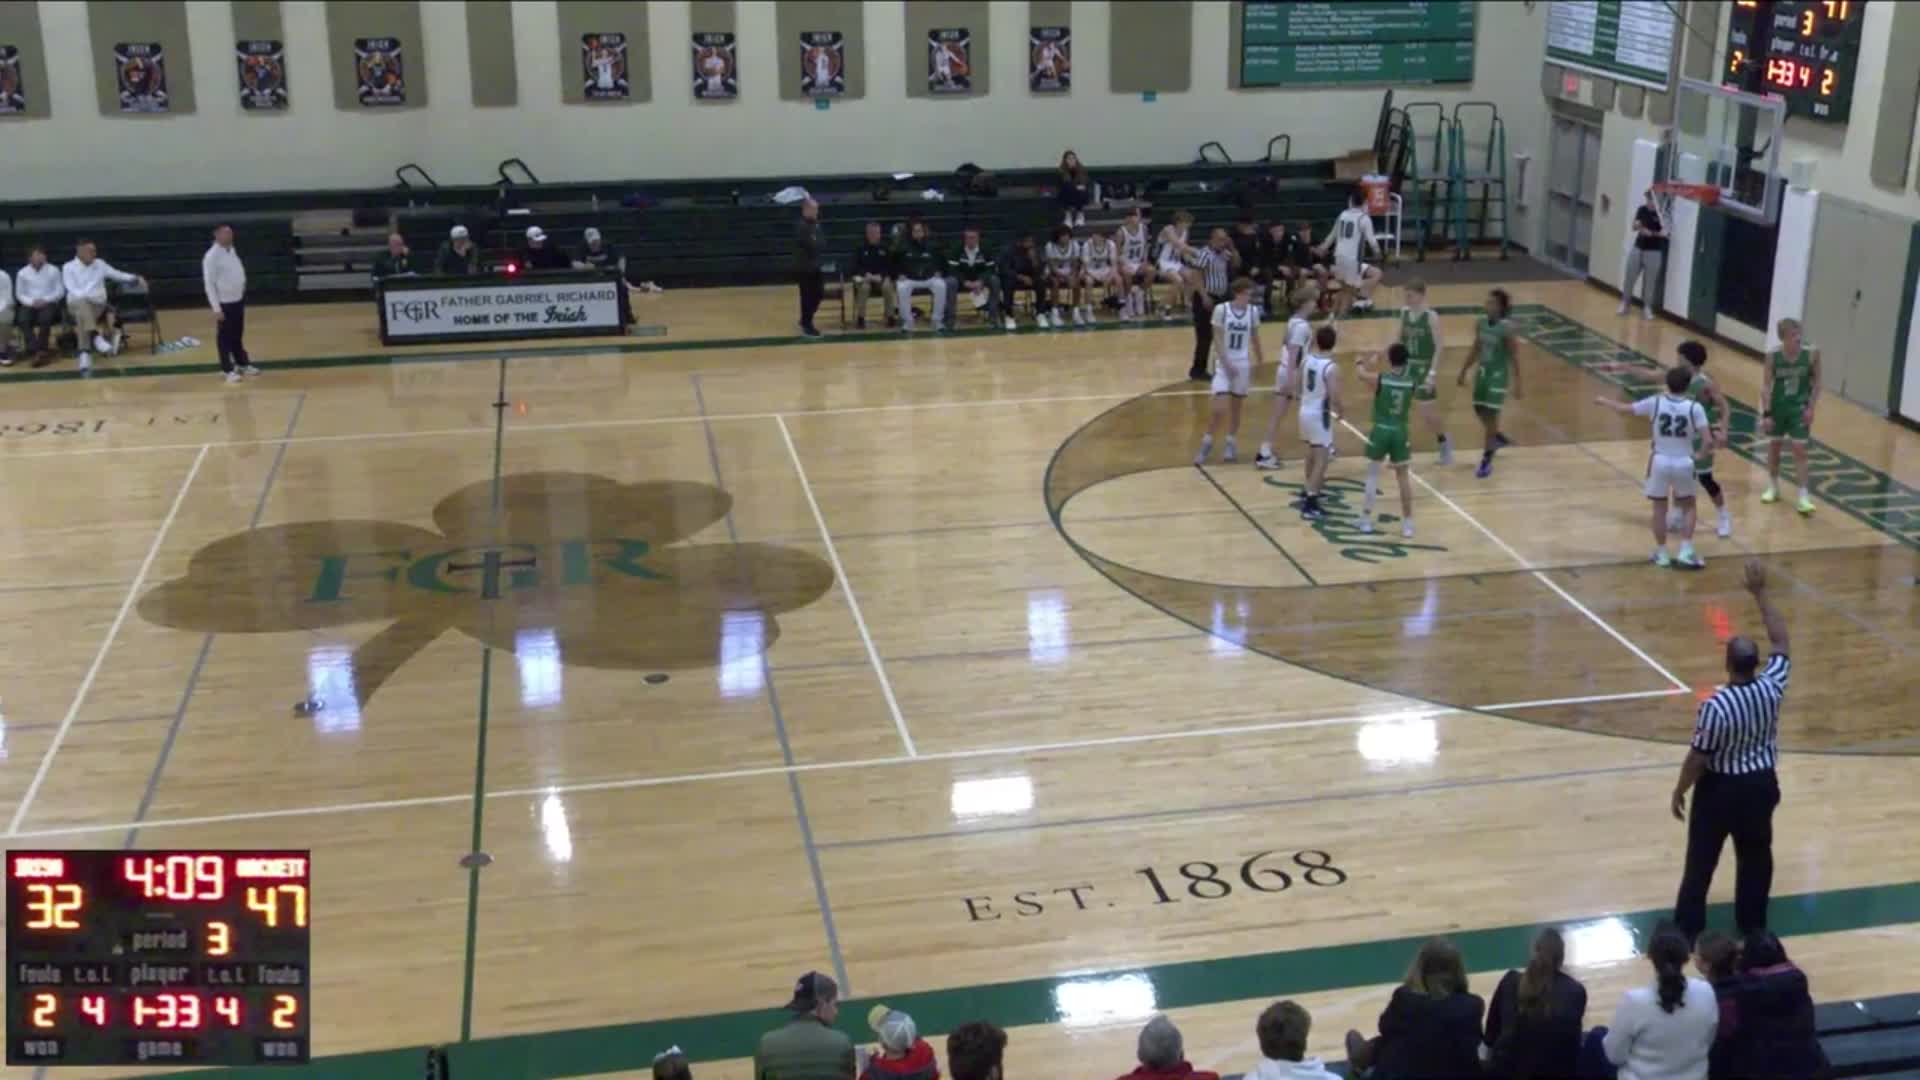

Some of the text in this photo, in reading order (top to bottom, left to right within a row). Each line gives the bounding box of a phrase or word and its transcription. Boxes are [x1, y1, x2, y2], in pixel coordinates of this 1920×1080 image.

[1802, 10, 1815, 36] 3
[1799, 65, 1811, 87] 4
[1821, 69, 1834, 95] 2
[440, 289, 616, 307] FATHER GABRIEL RICHARD
[453, 305, 588, 325] HOME OF THE Irish
[1229, 333, 1244, 350] 11
[1658, 413, 1689, 438] 22
[305, 539, 674, 603] FGR
[961, 849, 1348, 921] EST. 1868
